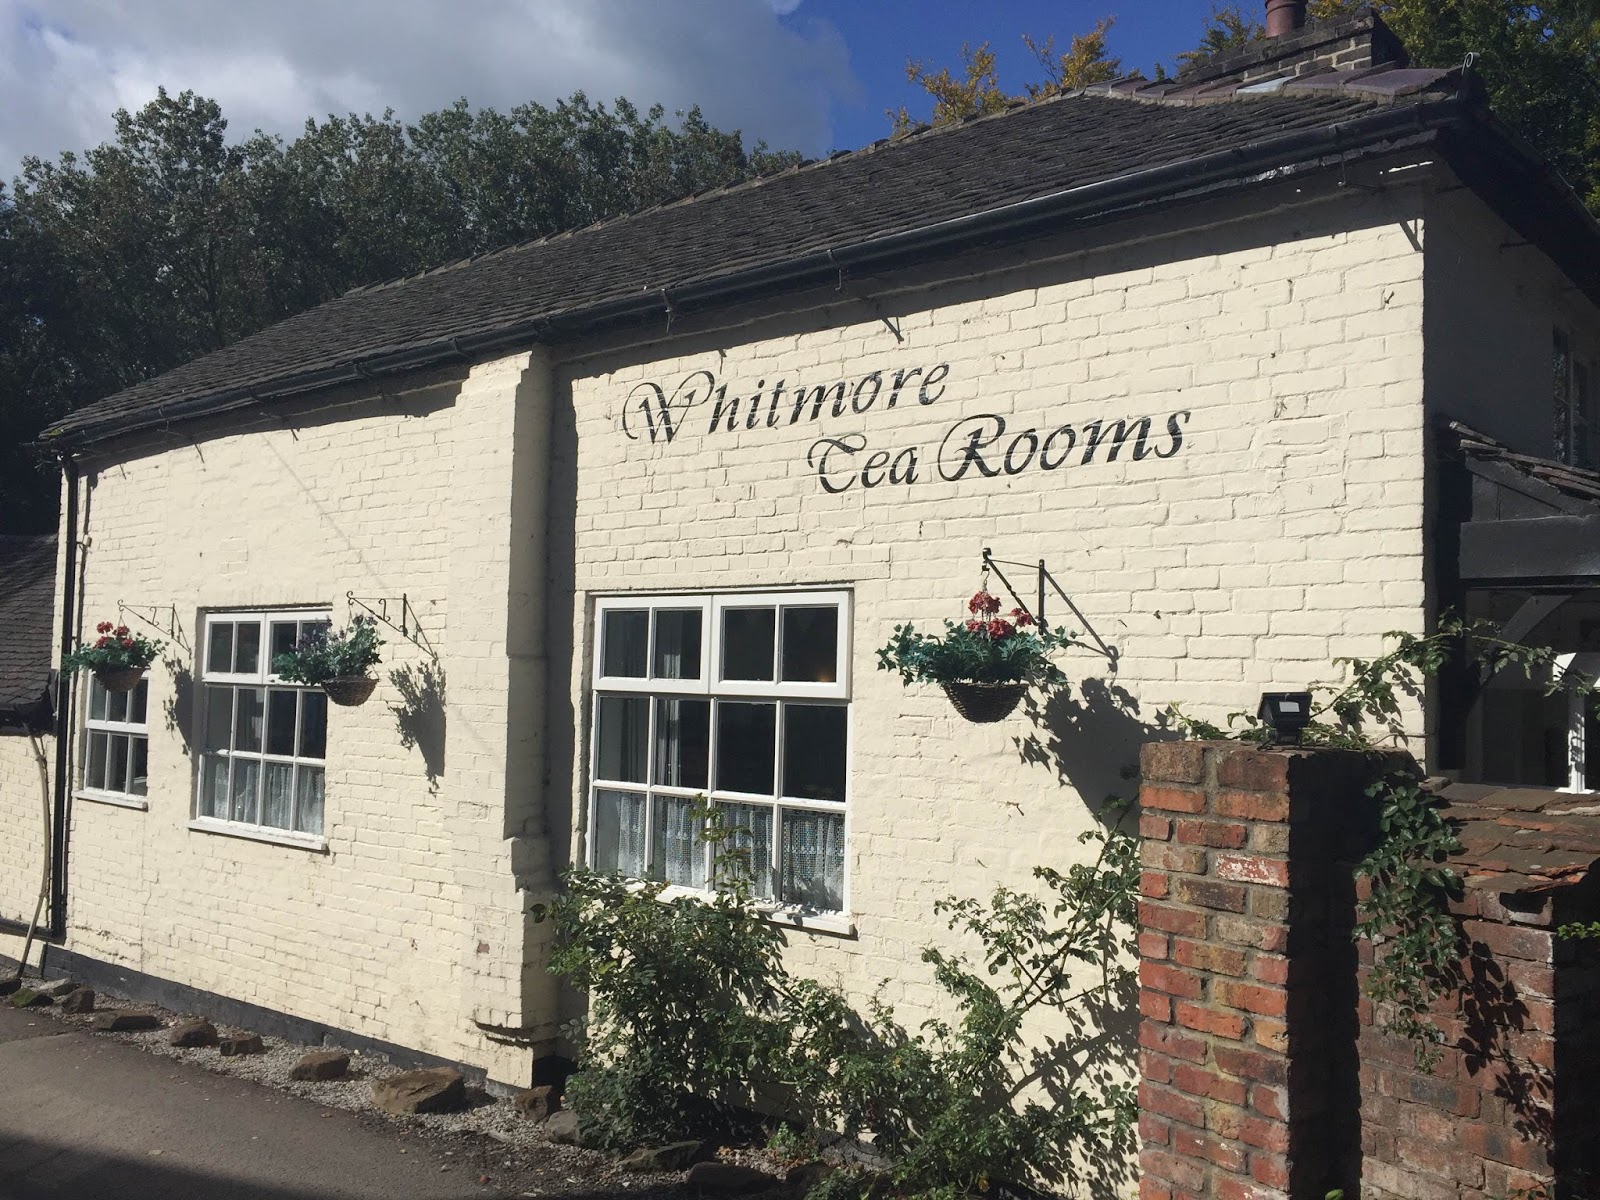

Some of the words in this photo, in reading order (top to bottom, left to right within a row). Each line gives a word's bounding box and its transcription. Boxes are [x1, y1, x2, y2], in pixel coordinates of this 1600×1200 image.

[622, 361, 949, 446] Whitmore
[807, 434, 919, 494] Tea
[937, 409, 1191, 482] Rooms
